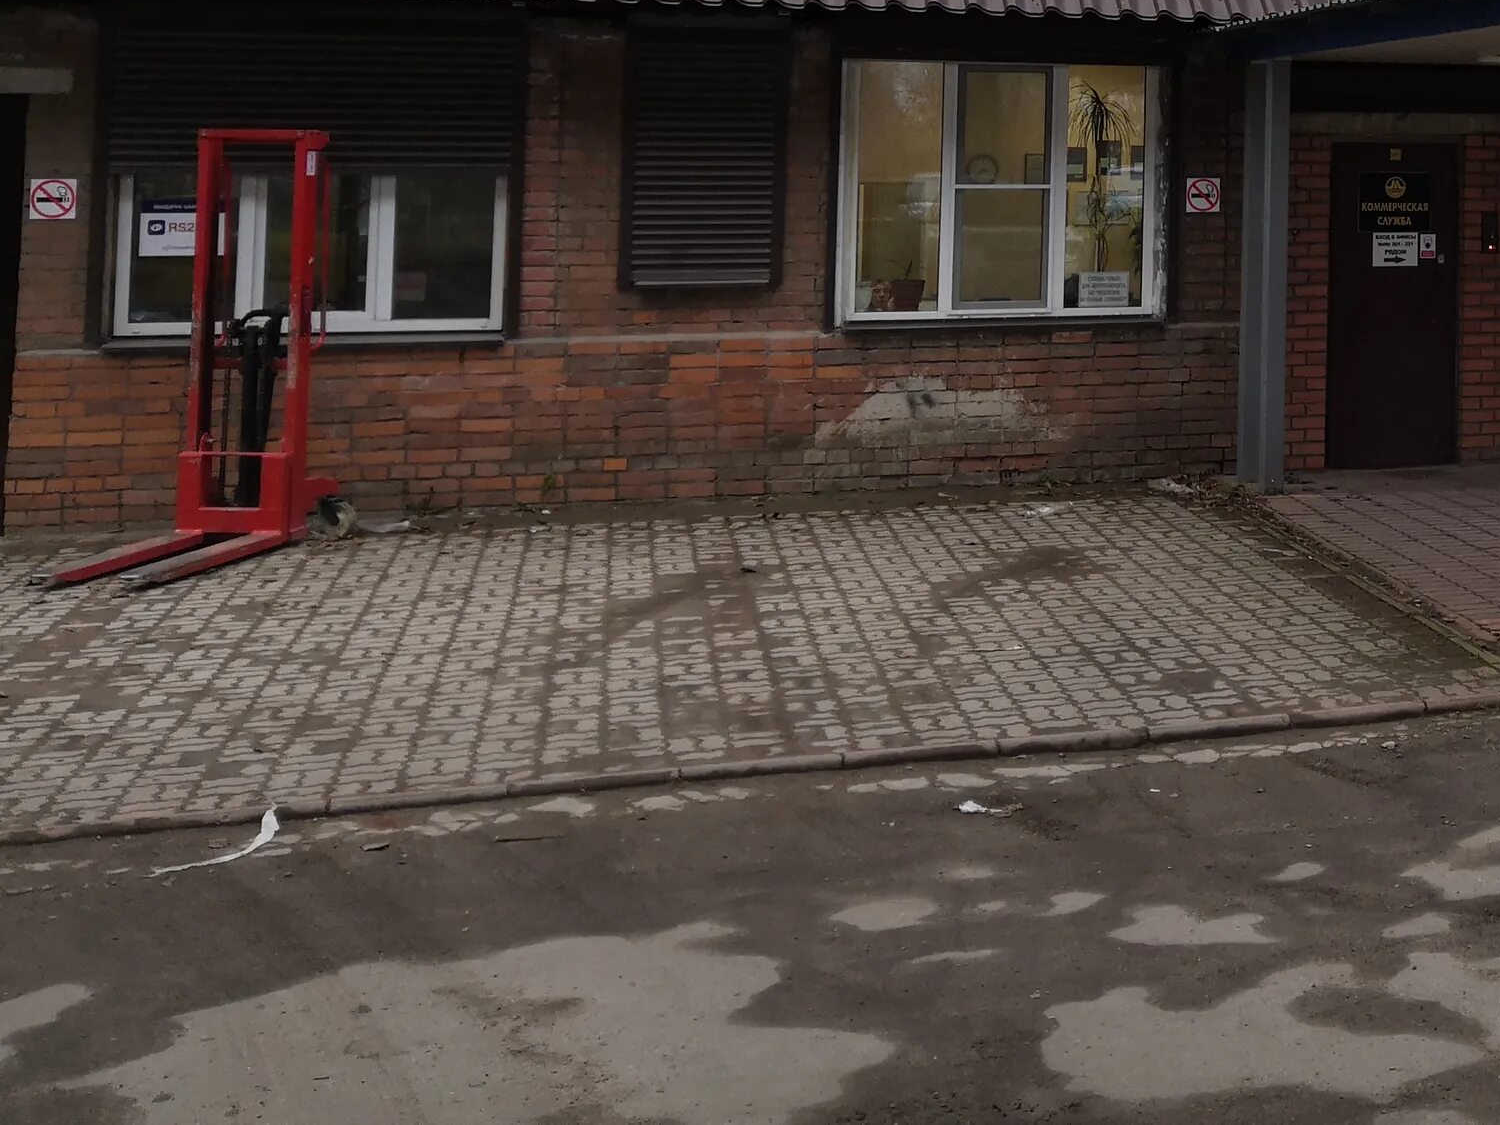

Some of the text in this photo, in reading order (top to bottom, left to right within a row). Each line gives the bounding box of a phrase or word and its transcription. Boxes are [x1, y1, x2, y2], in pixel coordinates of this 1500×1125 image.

[1361, 202, 1429, 212] КОММЕРЧЕСКАЯ
[1377, 216, 1412, 226] СЛУЖБА
[168, 222, 195, 233] RS2
